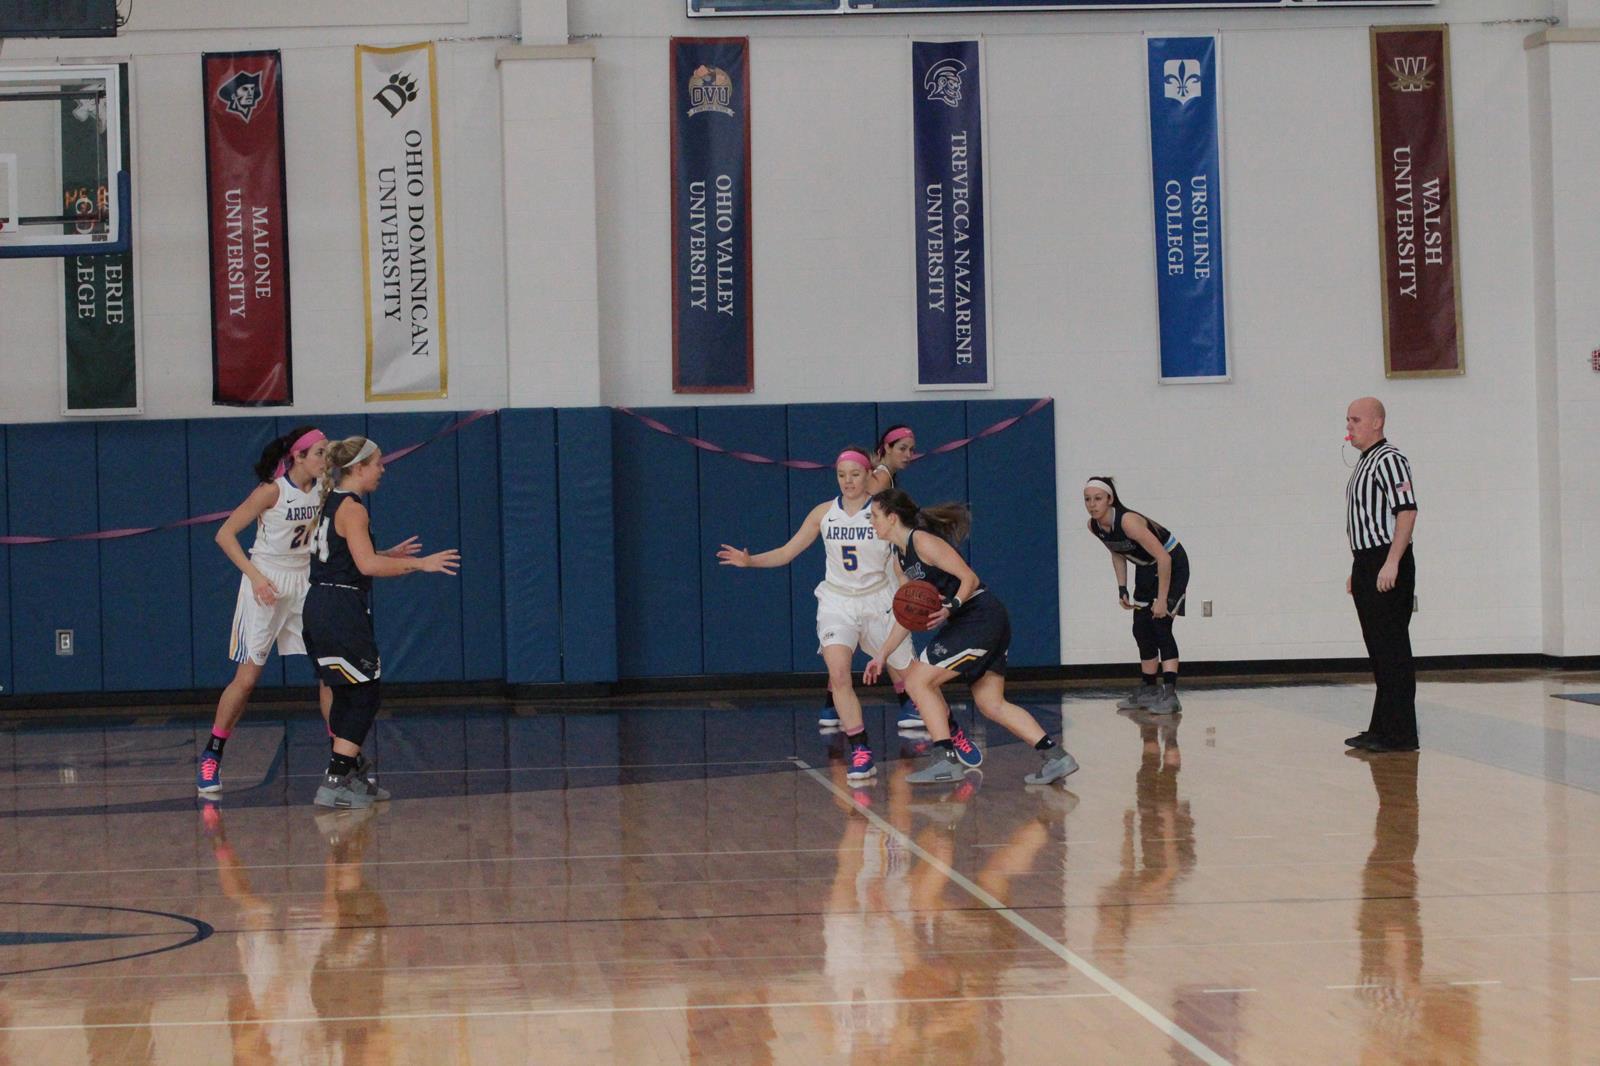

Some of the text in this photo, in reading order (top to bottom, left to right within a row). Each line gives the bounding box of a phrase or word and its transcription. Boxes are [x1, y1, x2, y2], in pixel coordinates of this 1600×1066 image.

[691, 86, 729, 106] OVU
[75, 198, 96, 318] COEGE
[225, 188, 245, 318] UNIVERSITY
[252, 206, 270, 298] MALONE
[379, 167, 401, 321] UNIVERSITY
[405, 130, 428, 355] OHIO DOMINICAN
[690, 182, 706, 310] UNIVERSITY
[716, 175, 733, 316] OHIO VALLEY
[927, 184, 944, 312] UNIVERSITY
[952, 131, 972, 364] TREVECCA NAZARENE
[1166, 180, 1183, 275] COLLEGE
[1191, 175, 1210, 279] URSULINE
[1394, 146, 1416, 298] UNIVERSITY
[1422, 177, 1442, 264] WALSH
[105, 264, 123, 324] ERIE
[285, 505, 320, 521] ARRO
[826, 526, 874, 540] ARROWS
[841, 545, 859, 571] 5
